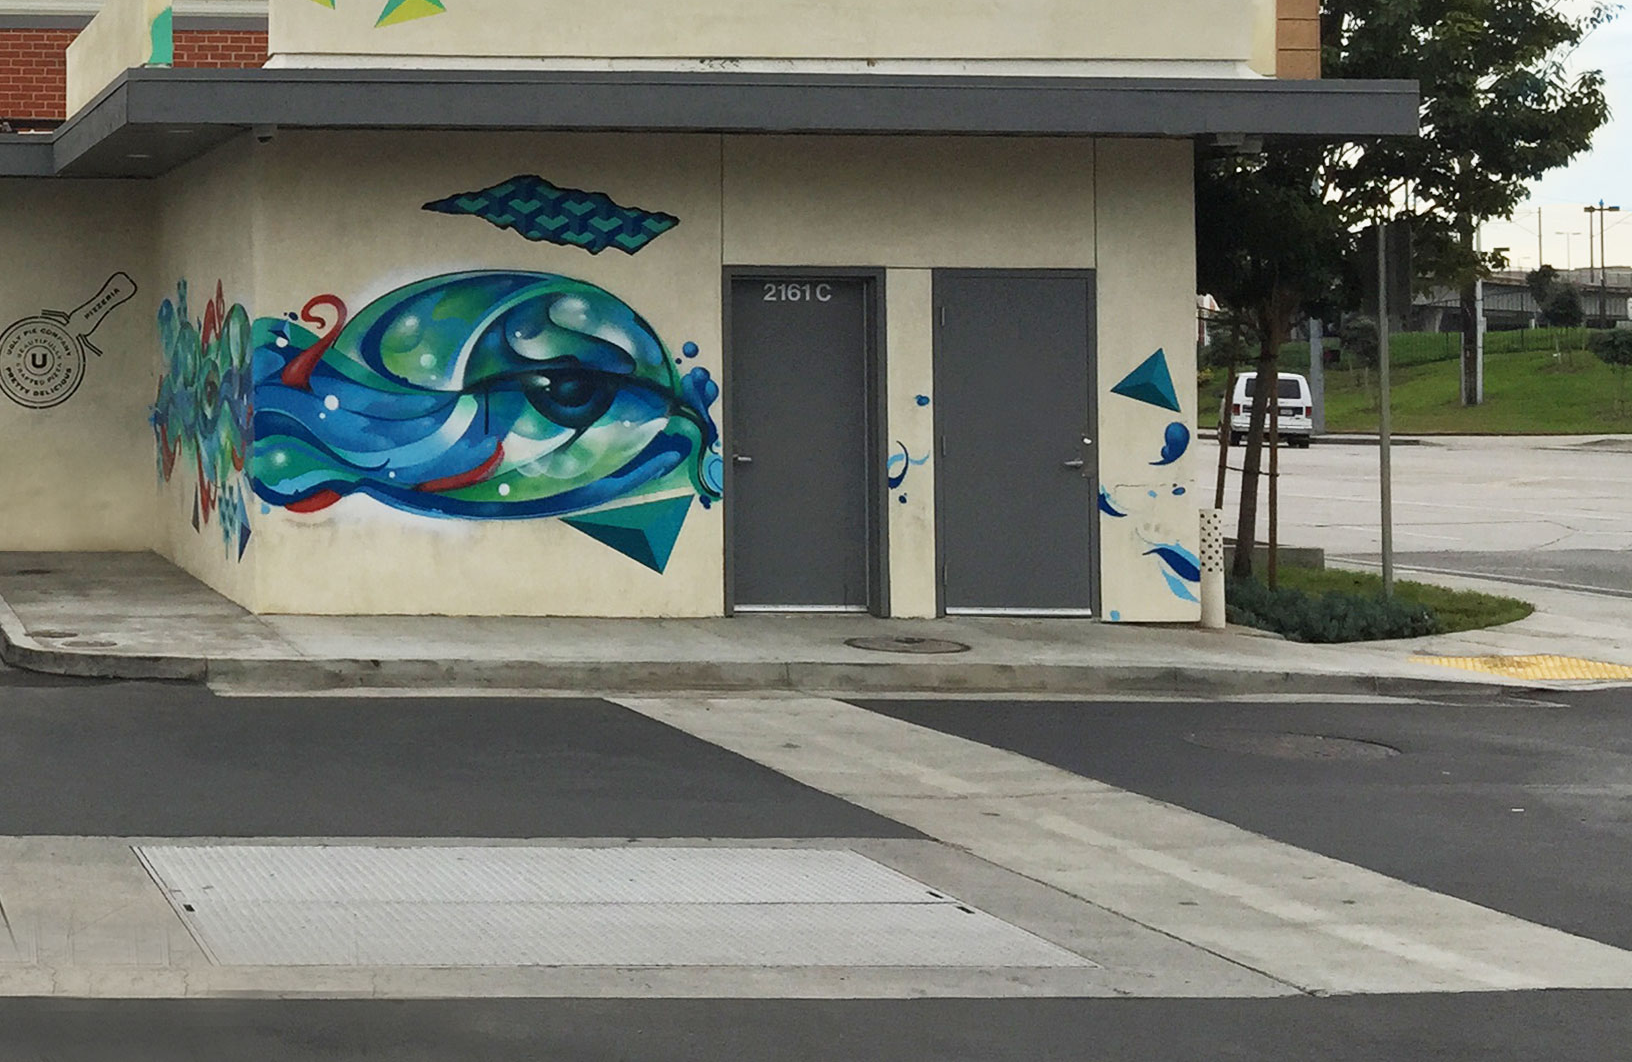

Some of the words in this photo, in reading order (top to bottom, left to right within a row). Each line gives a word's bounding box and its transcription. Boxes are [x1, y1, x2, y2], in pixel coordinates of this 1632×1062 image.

[84, 288, 120, 319] PIZZERIA
[6, 335, 21, 356] UGLY
[23, 328, 37, 336] PIE
[40, 328, 71, 356] COMPANY
[17, 338, 62, 359] BEAUTIFULLY
[16, 362, 45, 386] CRAFTED
[47, 362, 62, 382] PIZZA
[31, 353, 48, 369] U
[5, 366, 30, 394] PRETTY
[33, 367, 72, 396] DELICIOUS
